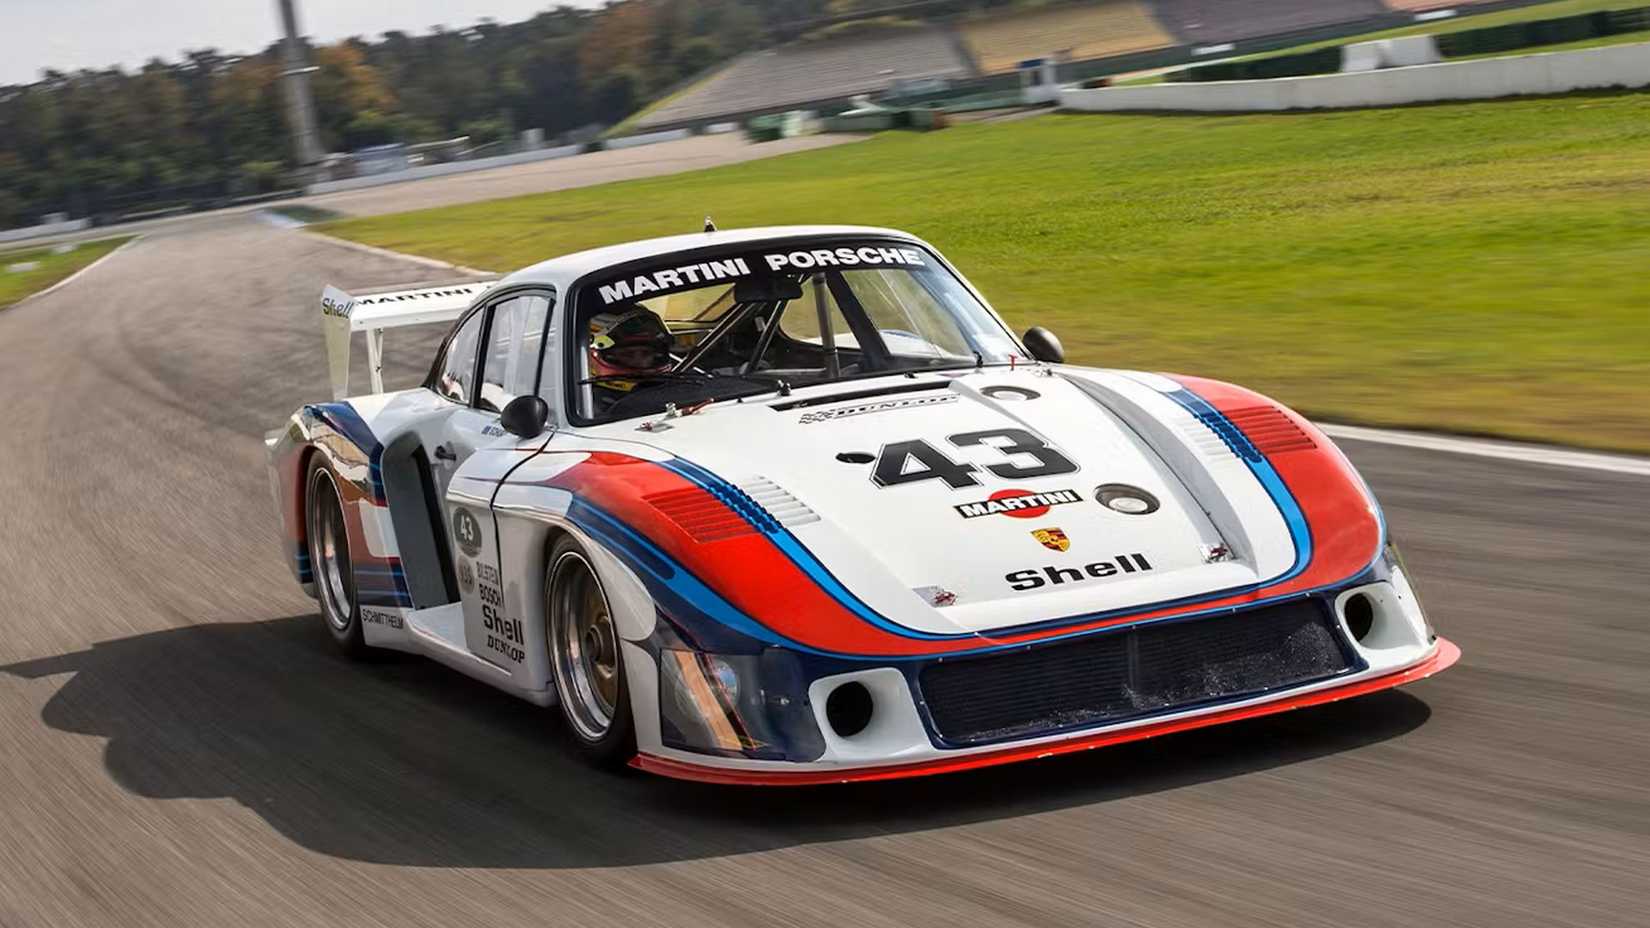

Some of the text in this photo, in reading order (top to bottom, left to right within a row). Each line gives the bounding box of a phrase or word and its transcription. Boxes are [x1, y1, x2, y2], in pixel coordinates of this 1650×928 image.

[599, 247, 925, 305] MARTINI PORSCHE
[322, 297, 354, 319] Shell
[355, 288, 473, 306] MARTINI
[868, 427, 1082, 491] 43
[965, 489, 1079, 517] MARTINI
[460, 514, 474, 541] 43
[1005, 553, 1153, 592] Shell
[482, 604, 524, 646] Shell
[487, 634, 525, 664] DUNLOP
